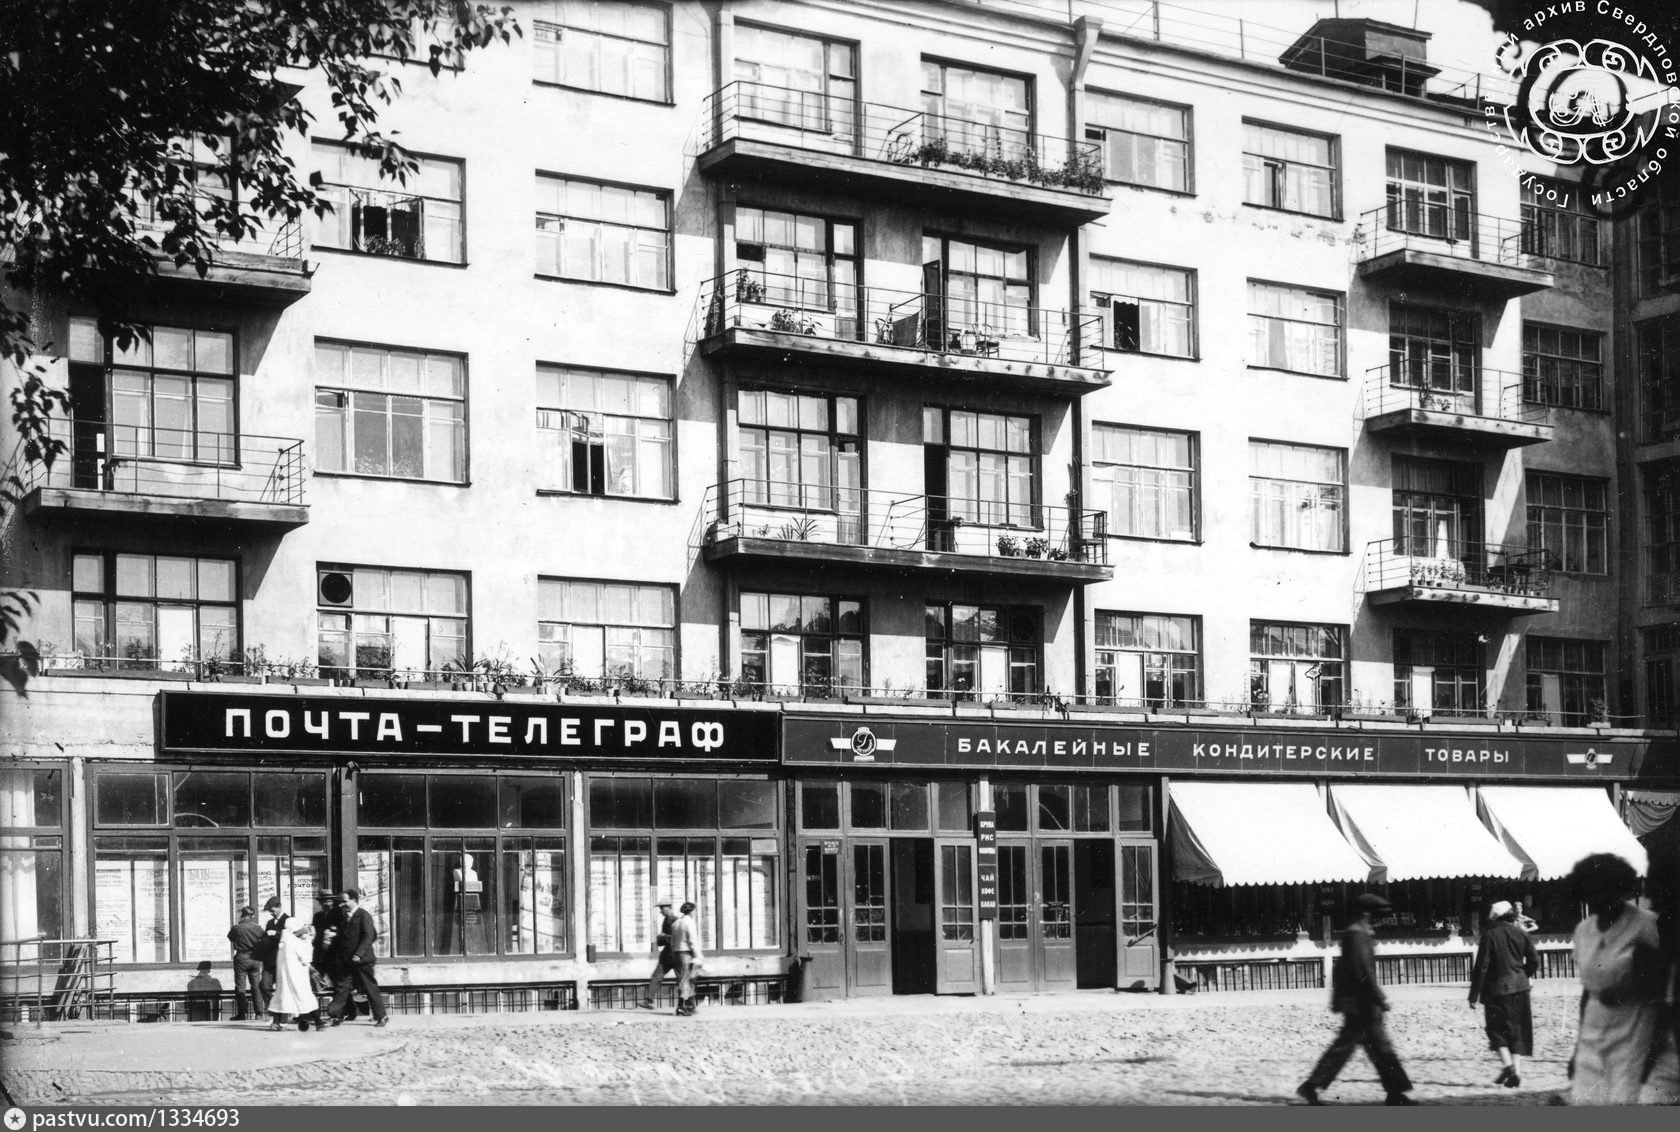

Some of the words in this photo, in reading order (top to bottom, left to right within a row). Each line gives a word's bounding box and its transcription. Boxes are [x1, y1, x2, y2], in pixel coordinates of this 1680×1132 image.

[957, 737, 1151, 757] БАКАЛЕЙНЫЕ
[1192, 743, 1375, 762] КОНДИТЕРСКИЕ
[1424, 748, 1510, 764] ТОВАРЫ
[981, 873, 995, 882] ЧАЙ
